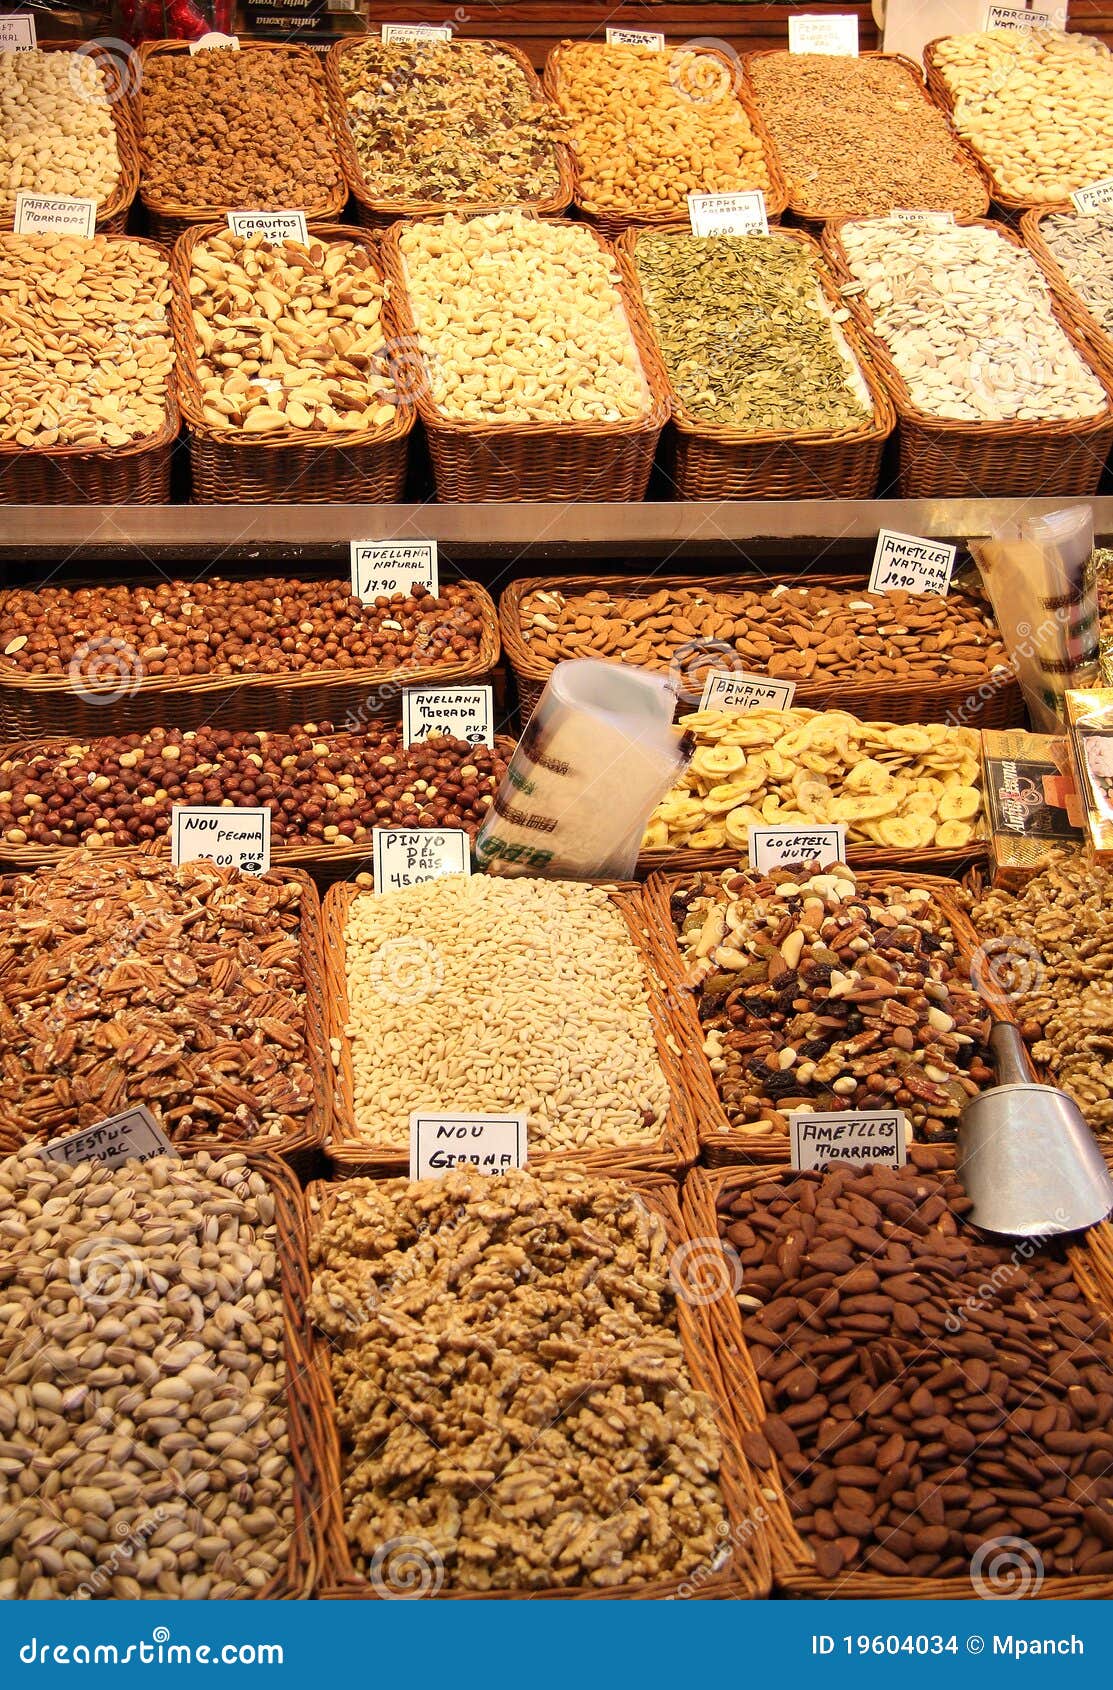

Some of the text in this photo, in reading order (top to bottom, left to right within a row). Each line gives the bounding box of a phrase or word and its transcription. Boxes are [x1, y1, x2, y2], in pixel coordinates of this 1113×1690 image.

[991, 8, 1045, 21] MARCONA
[24, 200, 86, 213] MARCONA
[25, 210, 85, 225] TORRADAS
[361, 549, 429, 560] AVELLANA
[884, 540, 950, 565] AMETLLES
[373, 559, 425, 571] NATURAL
[716, 680, 777, 699] BANANA
[416, 695, 481, 705] AVELLANA
[724, 695, 760, 709] CHIP
[420, 706, 476, 718] TORRADA
[184, 817, 219, 831] NOU
[216, 830, 262, 843] PECANA
[386, 833, 446, 849] PINYO
[766, 836, 832, 848] COCKTEIL
[406, 847, 435, 858] DEL
[780, 847, 822, 860] NUTTY
[436, 1125, 484, 1139] NOU
[803, 1122, 896, 1141] AMETLLES
[63, 1124, 133, 1158] FESTUC
[816, 1143, 896, 1159] TORRADAS
